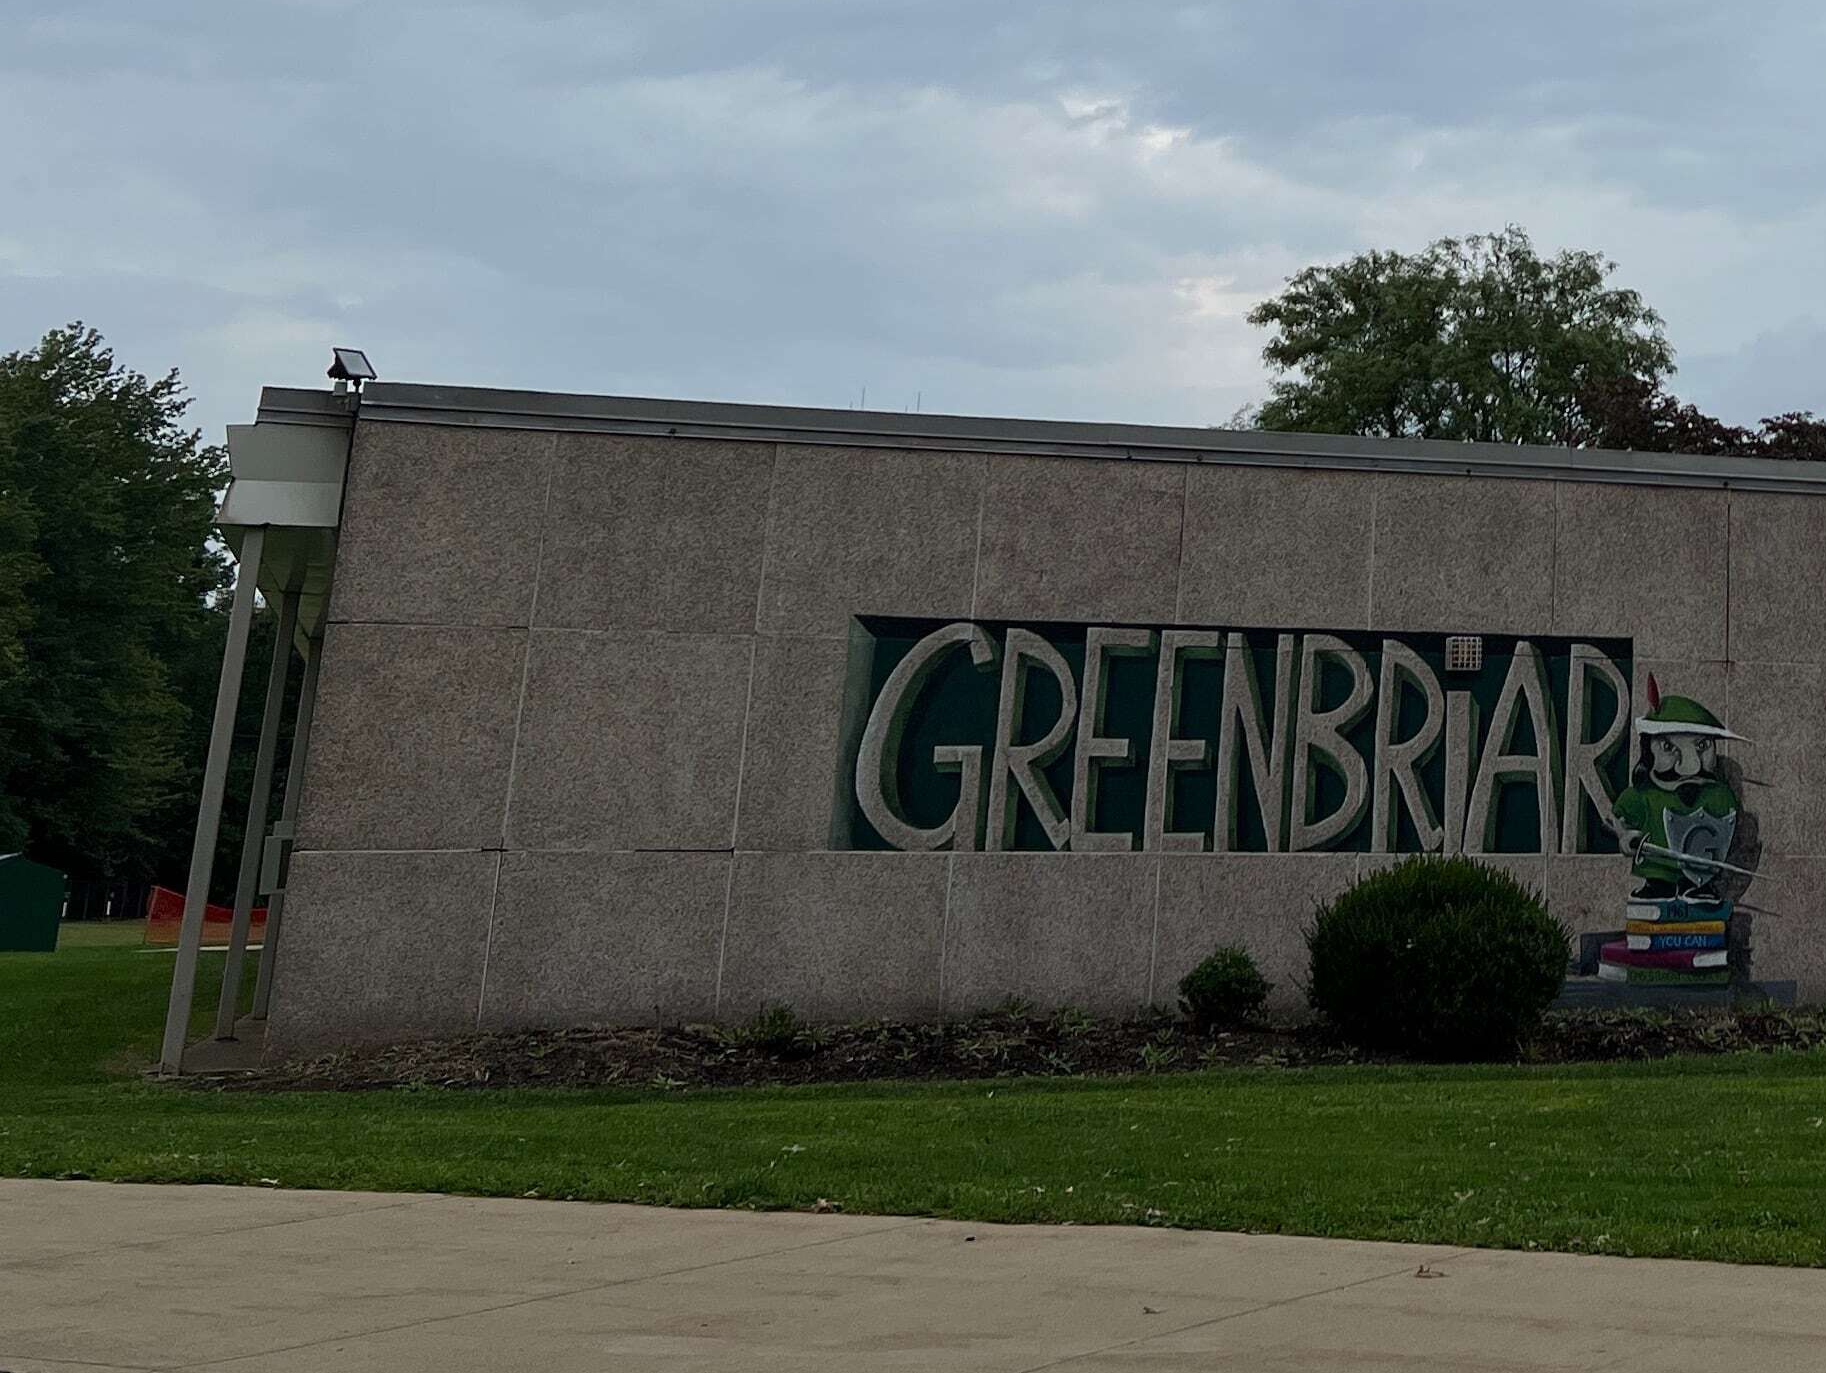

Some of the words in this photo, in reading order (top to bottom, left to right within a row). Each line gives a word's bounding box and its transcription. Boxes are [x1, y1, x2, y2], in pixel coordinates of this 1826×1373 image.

[1681, 824, 1722, 875] G
[1660, 936, 1681, 948] YOU
[1684, 936, 1707, 948] CAN
